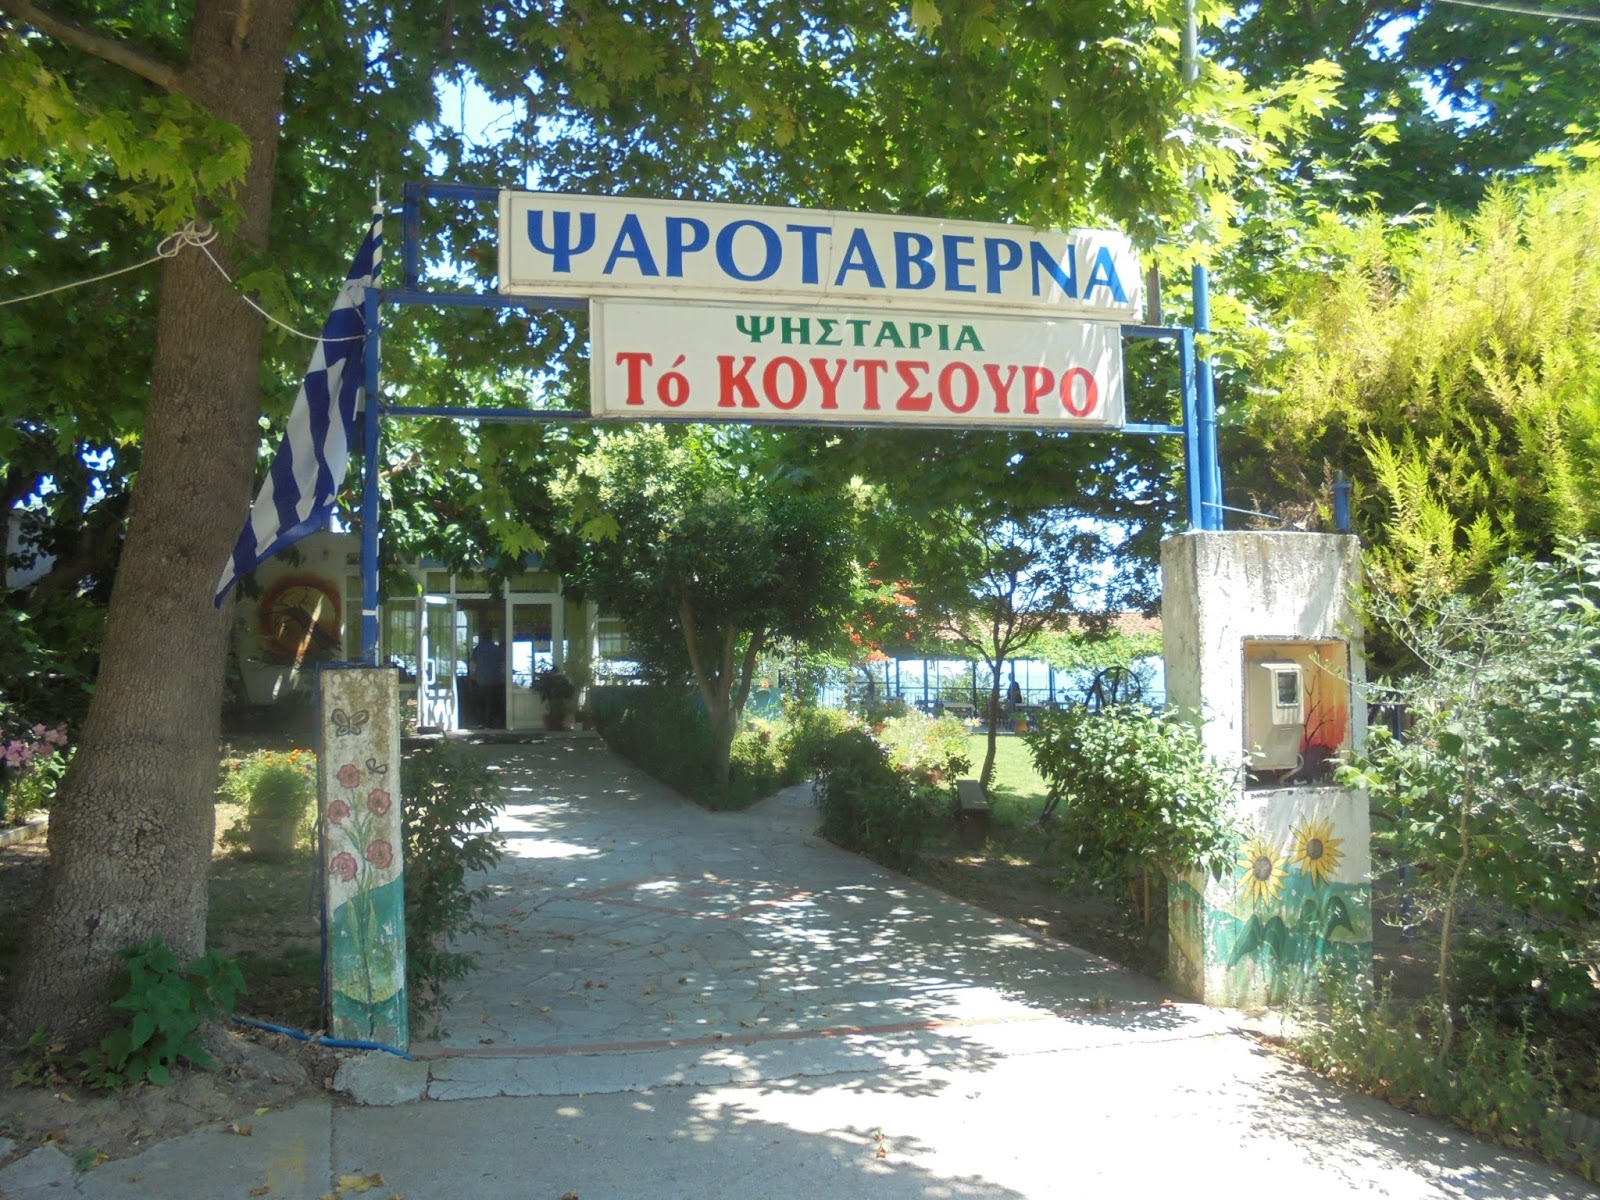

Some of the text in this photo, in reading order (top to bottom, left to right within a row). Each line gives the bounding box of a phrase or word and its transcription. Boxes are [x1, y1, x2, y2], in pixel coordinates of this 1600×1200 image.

[527, 209, 1129, 303] ΨΑΡΟΤΑΒΕΡΝΑ
[736, 314, 985, 352] ΨΗΣΤΑΡΙΑ
[717, 355, 1099, 418] ΚΟΥΤΣΟΥΡΟ
